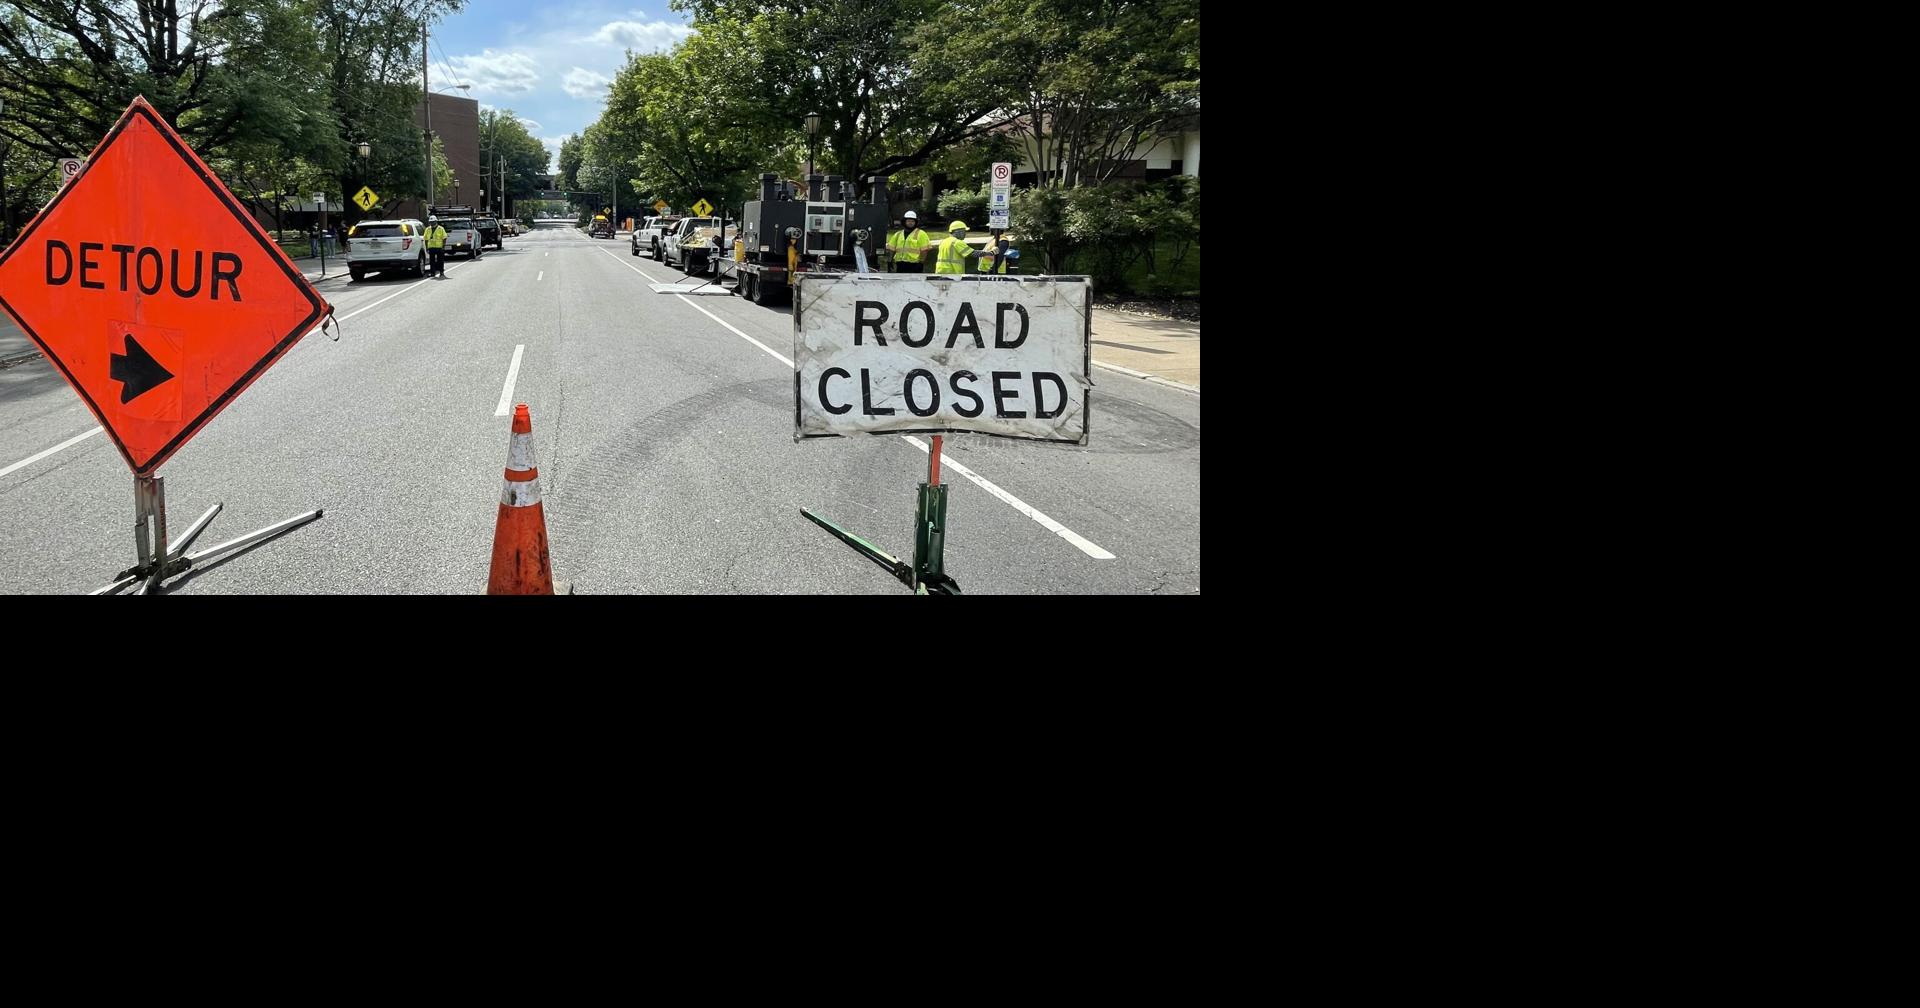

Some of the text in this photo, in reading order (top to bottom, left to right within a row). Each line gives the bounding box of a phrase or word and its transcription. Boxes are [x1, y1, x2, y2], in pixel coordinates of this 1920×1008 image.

[45, 239, 244, 302] DETOUR
[853, 300, 1031, 350] ROAD
[817, 366, 1069, 420] CLOSED
